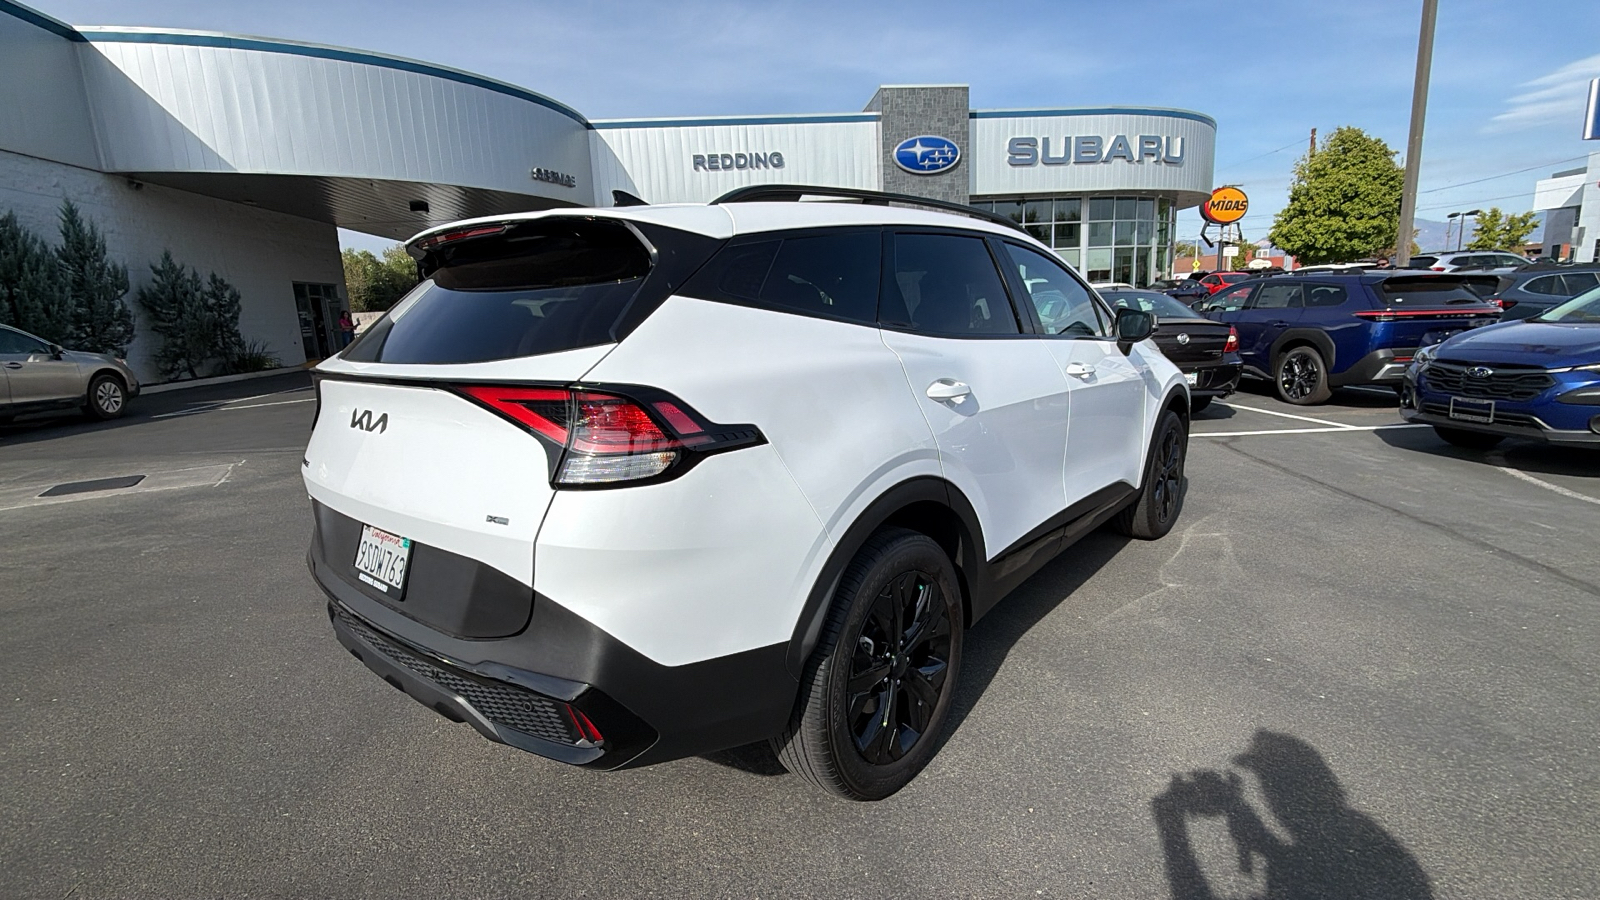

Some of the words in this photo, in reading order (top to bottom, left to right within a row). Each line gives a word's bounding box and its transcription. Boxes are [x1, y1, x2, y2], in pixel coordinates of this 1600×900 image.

[692, 152, 784, 171] REDDING
[1007, 134, 1185, 166] SUBARU
[1209, 196, 1248, 211] MIDAS
[350, 408, 388, 434] KIA
[357, 540, 405, 586] 9SDW763
